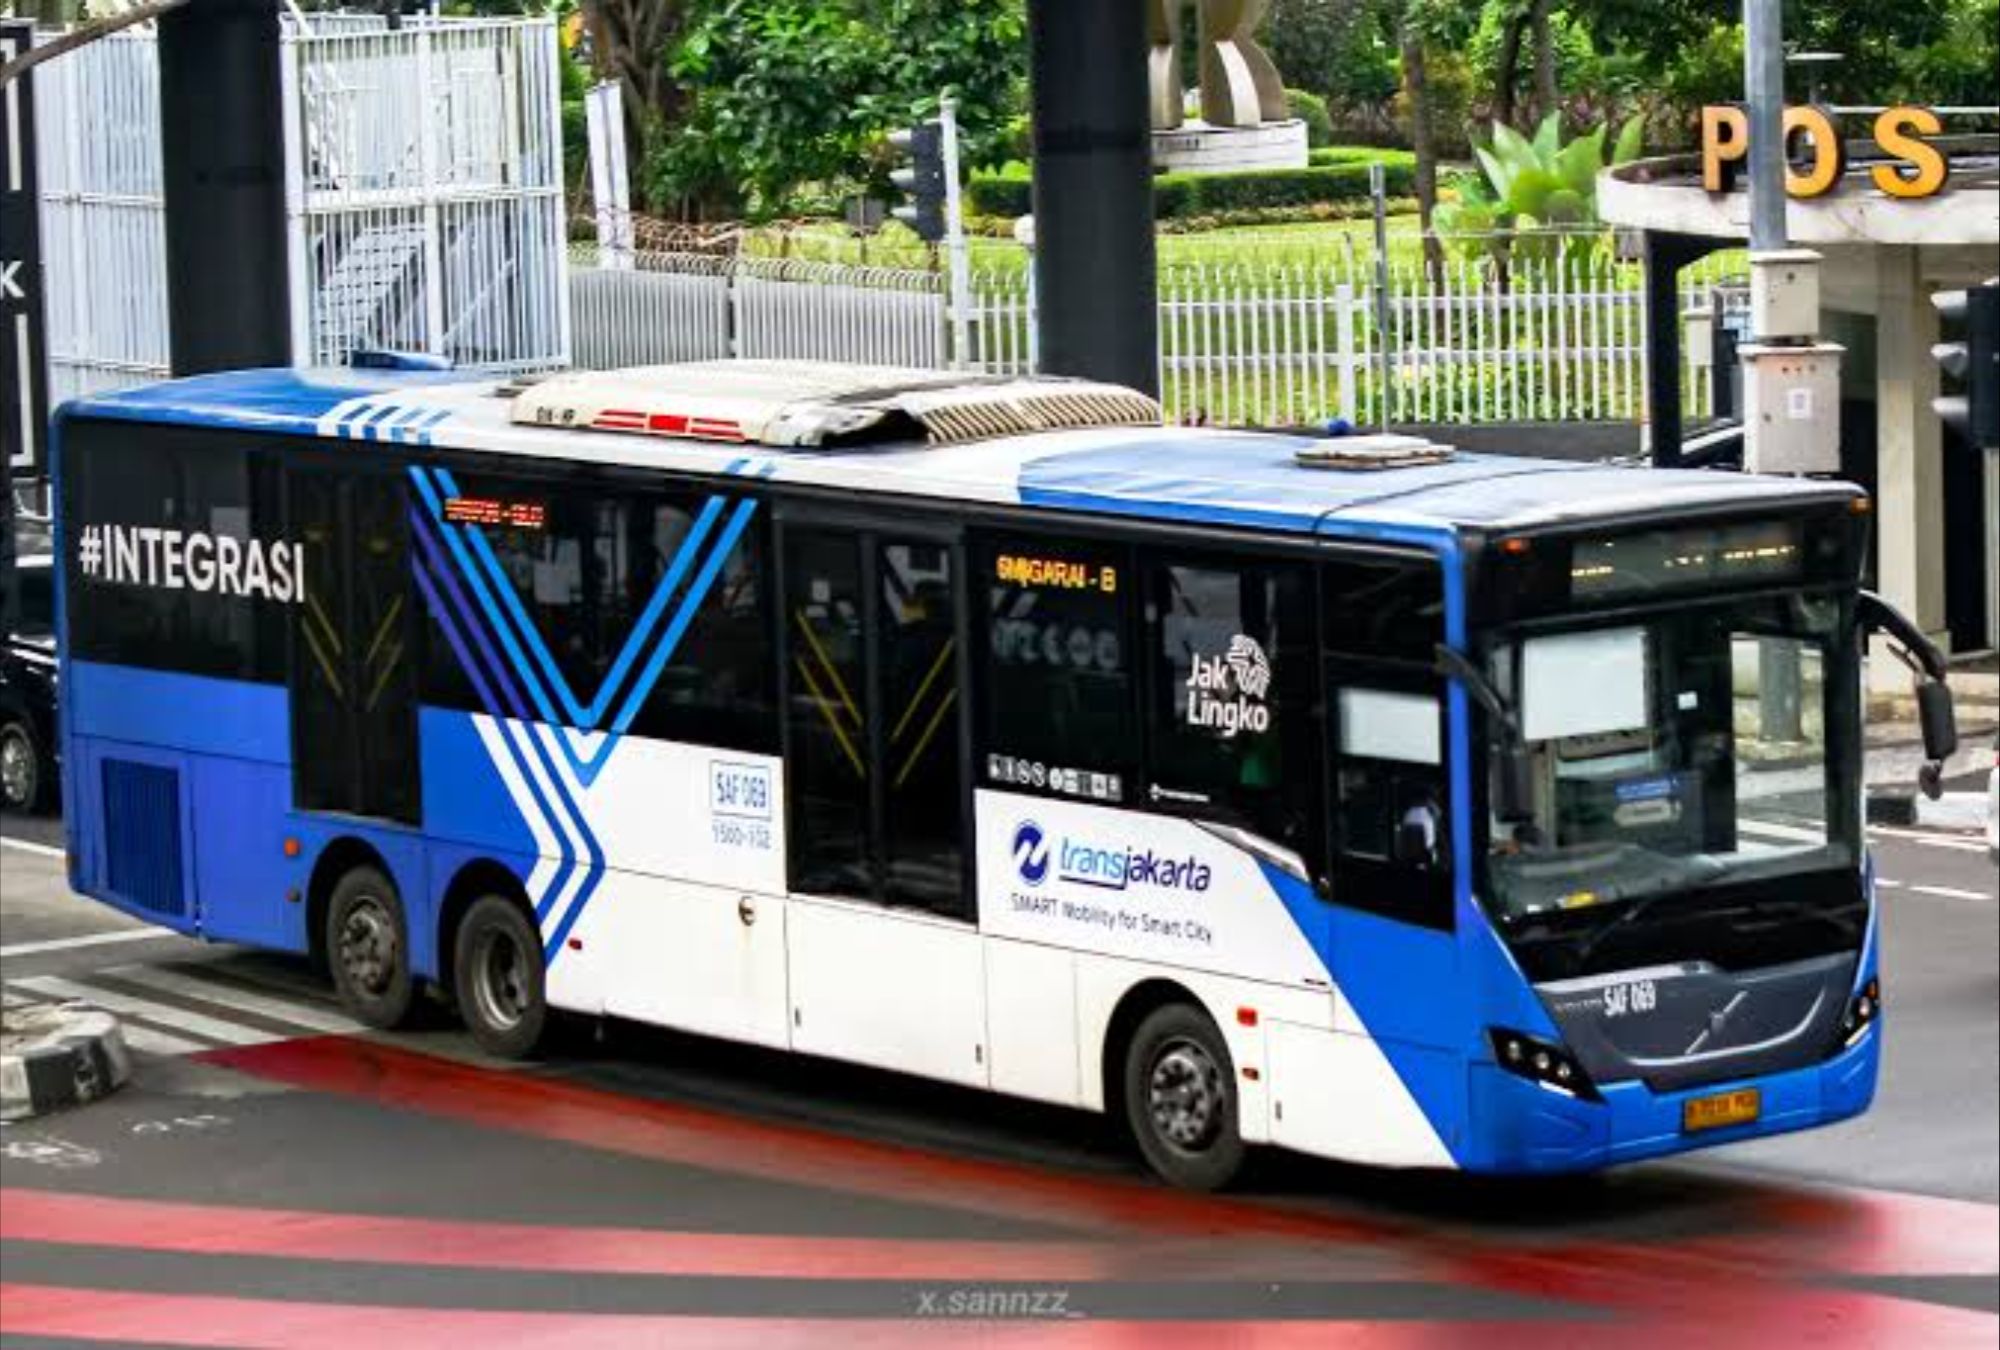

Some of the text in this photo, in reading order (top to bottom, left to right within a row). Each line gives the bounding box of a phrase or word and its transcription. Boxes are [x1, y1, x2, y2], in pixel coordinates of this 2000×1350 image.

[1701, 104, 1949, 198] POS
[79, 524, 305, 603] #INTEGRASI
[1186, 652, 1229, 690] Jak
[1187, 690, 1269, 737] Lingko
[1058, 836, 1212, 893] transjakarta
[1011, 893, 1213, 944] SMART Mobility for Smart City
[1603, 984, 1628, 1017] SAF
